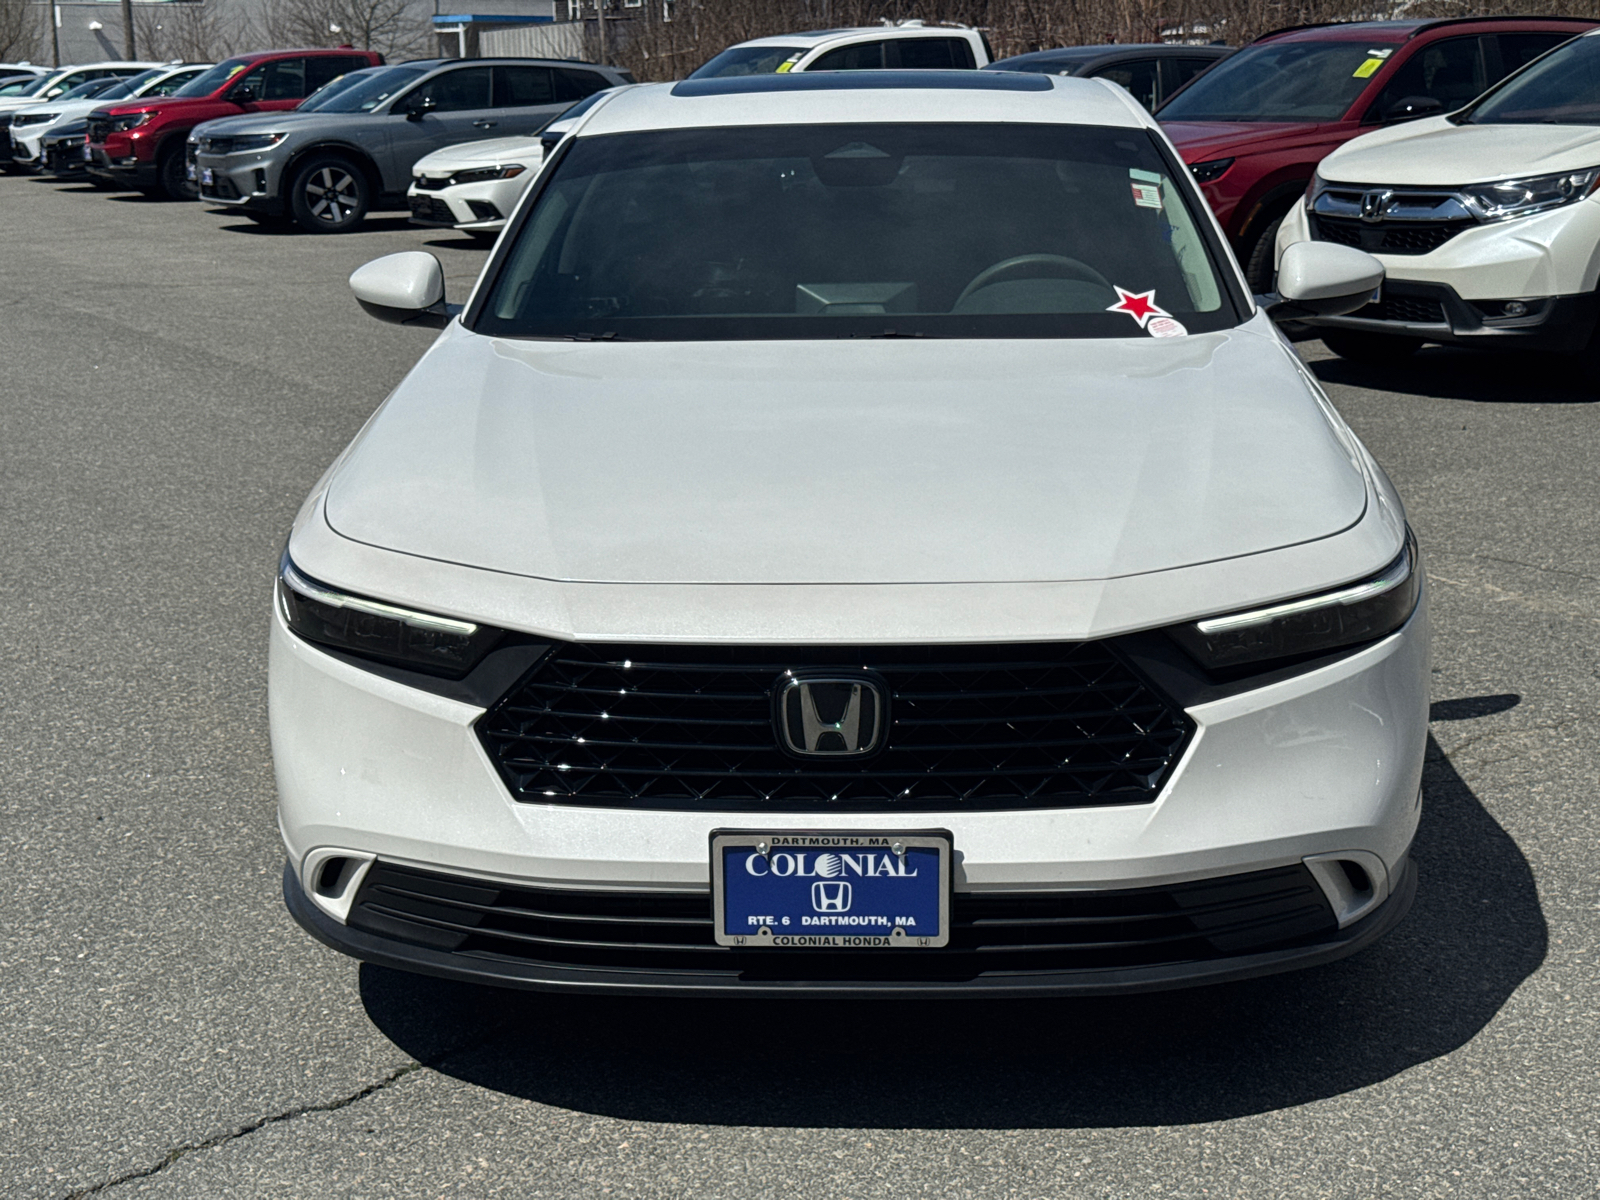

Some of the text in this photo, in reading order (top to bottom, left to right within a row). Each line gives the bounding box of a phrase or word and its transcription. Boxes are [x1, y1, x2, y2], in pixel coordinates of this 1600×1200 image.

[771, 837, 890, 846] DARTMOUTH, MA
[745, 853, 918, 878] COLONIAL
[747, 915, 917, 928] RTE. 6 DARTMOUTH, MA
[772, 936, 891, 946] COLONIAL HONDA
